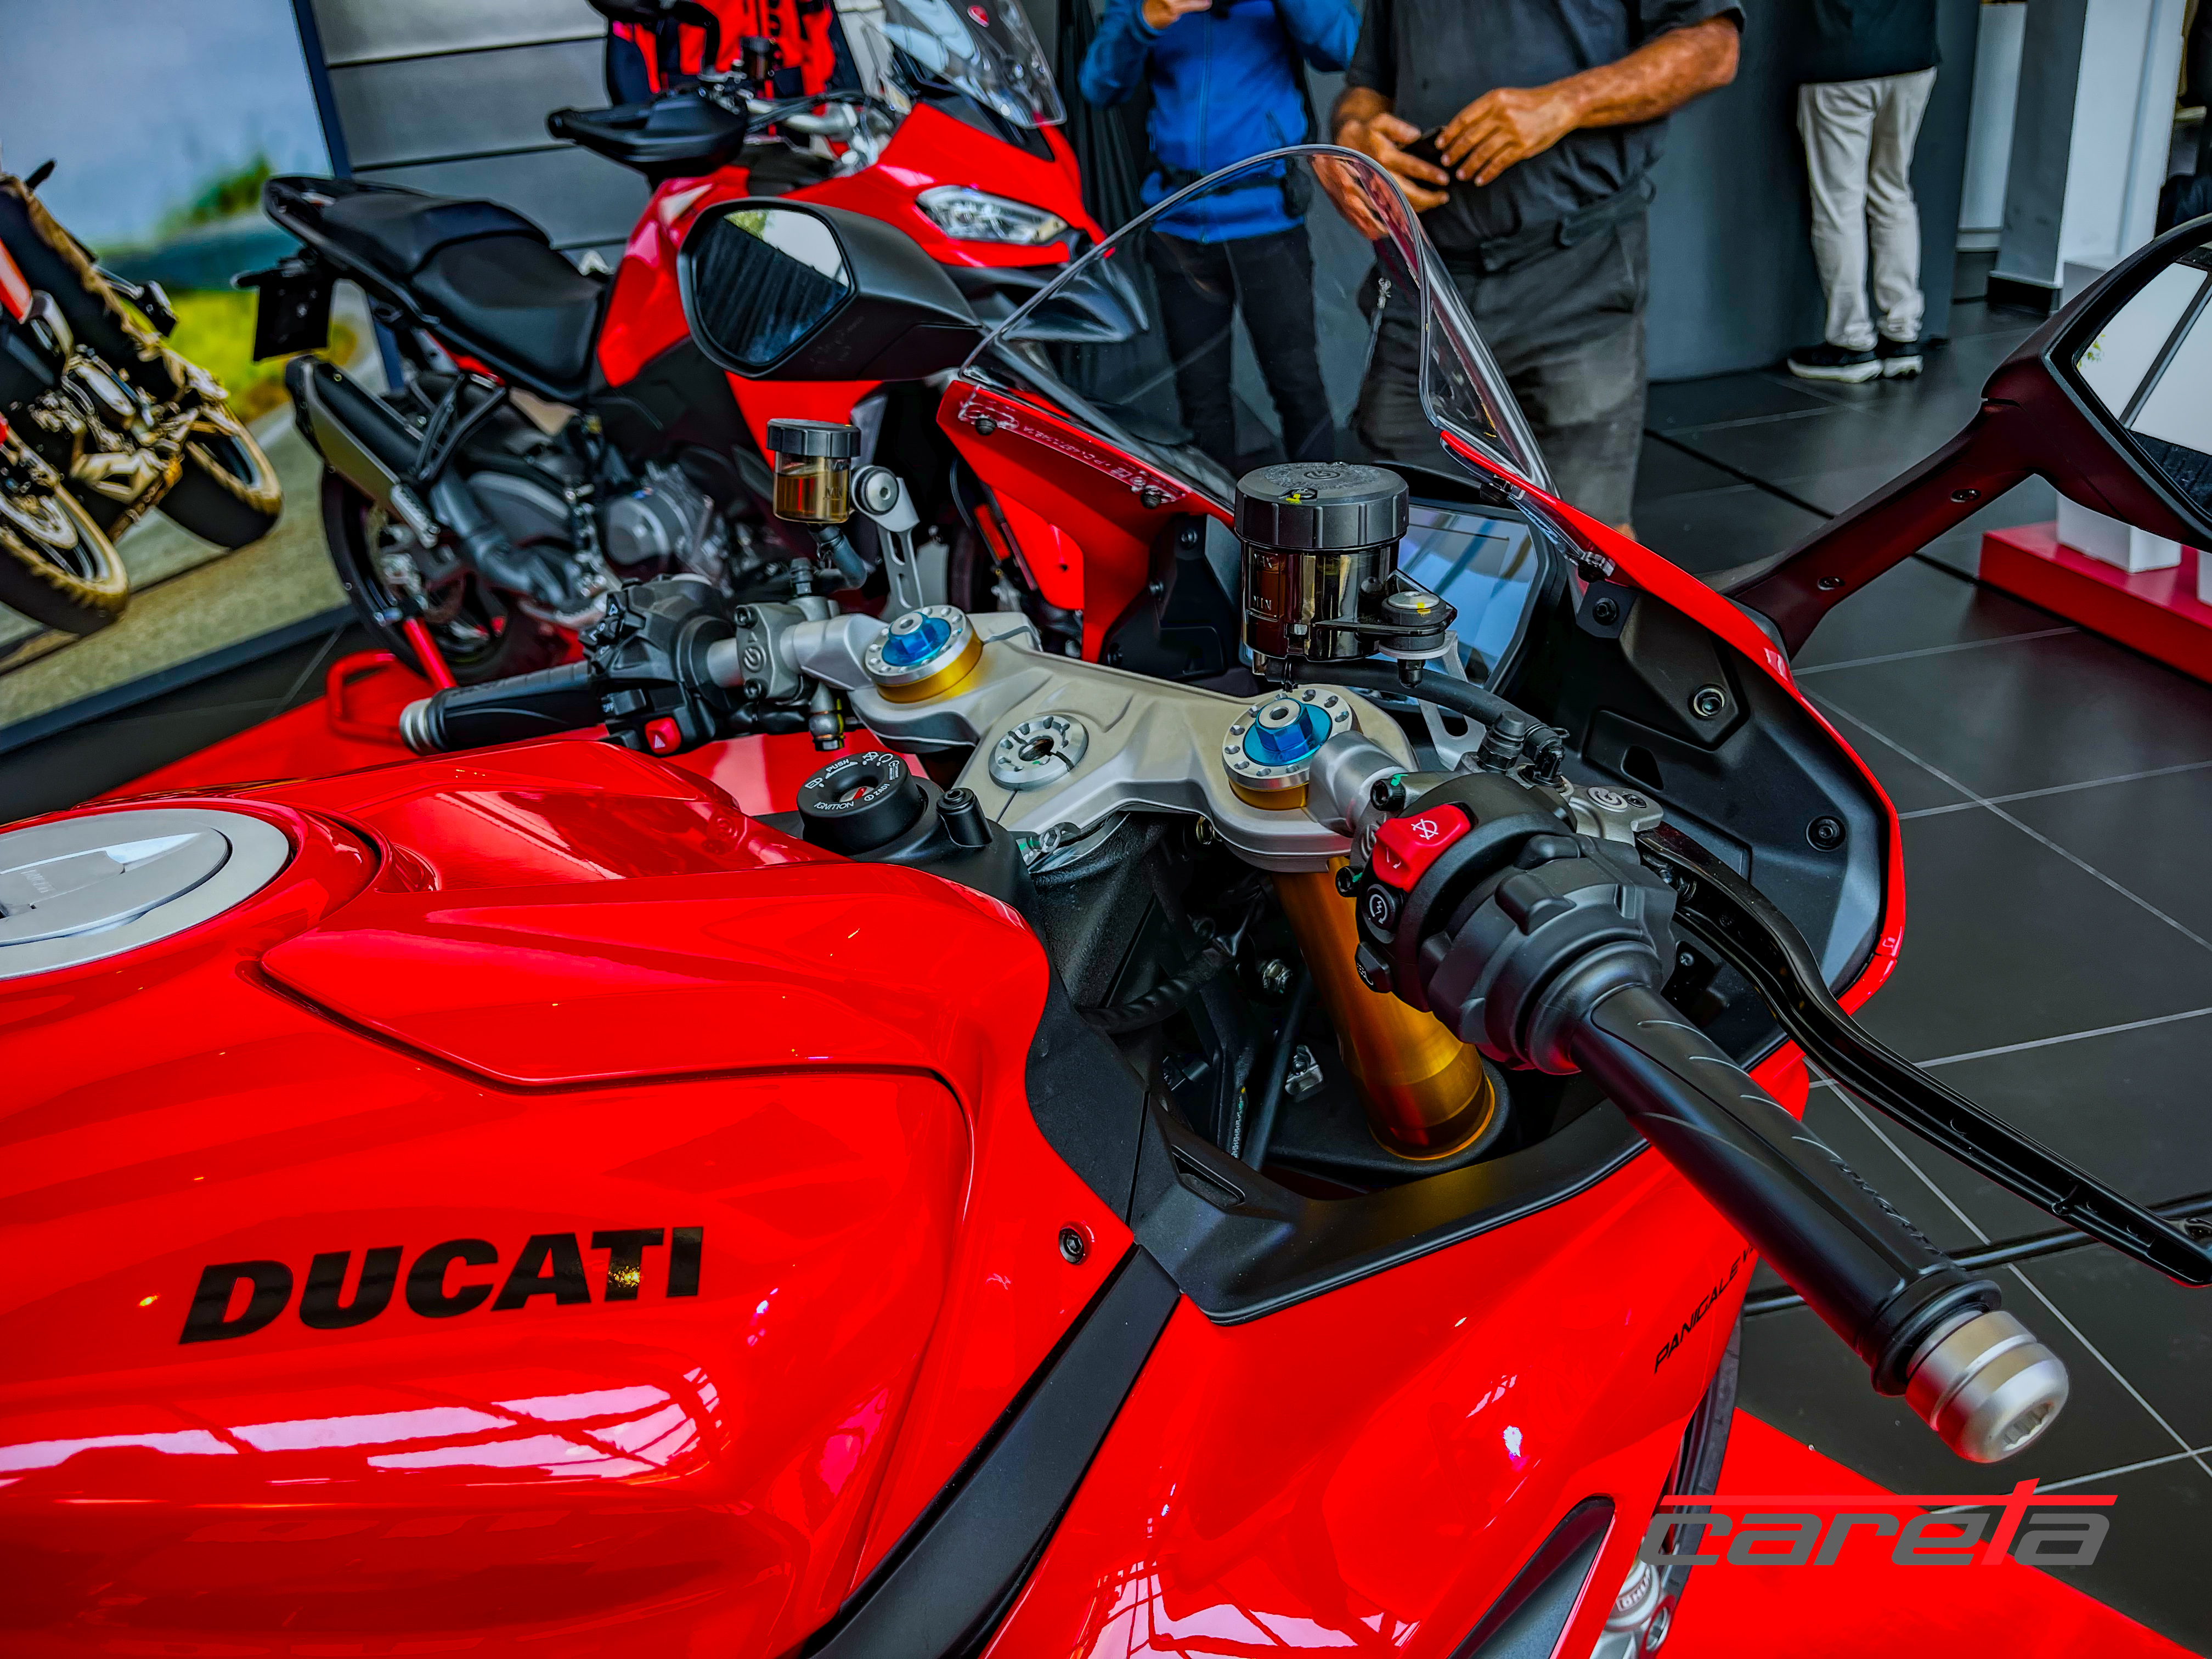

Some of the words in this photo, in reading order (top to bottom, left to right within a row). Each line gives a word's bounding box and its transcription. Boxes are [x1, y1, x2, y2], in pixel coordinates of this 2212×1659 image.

[1252, 595, 1272, 611] MIN
[826, 759, 849, 772] PUSH
[873, 783, 891, 796] ZADI
[814, 801, 855, 810] IGNITION
[179, 1227, 703, 1345] DUCATI
[1654, 1255, 1741, 1375] PANIGALE
